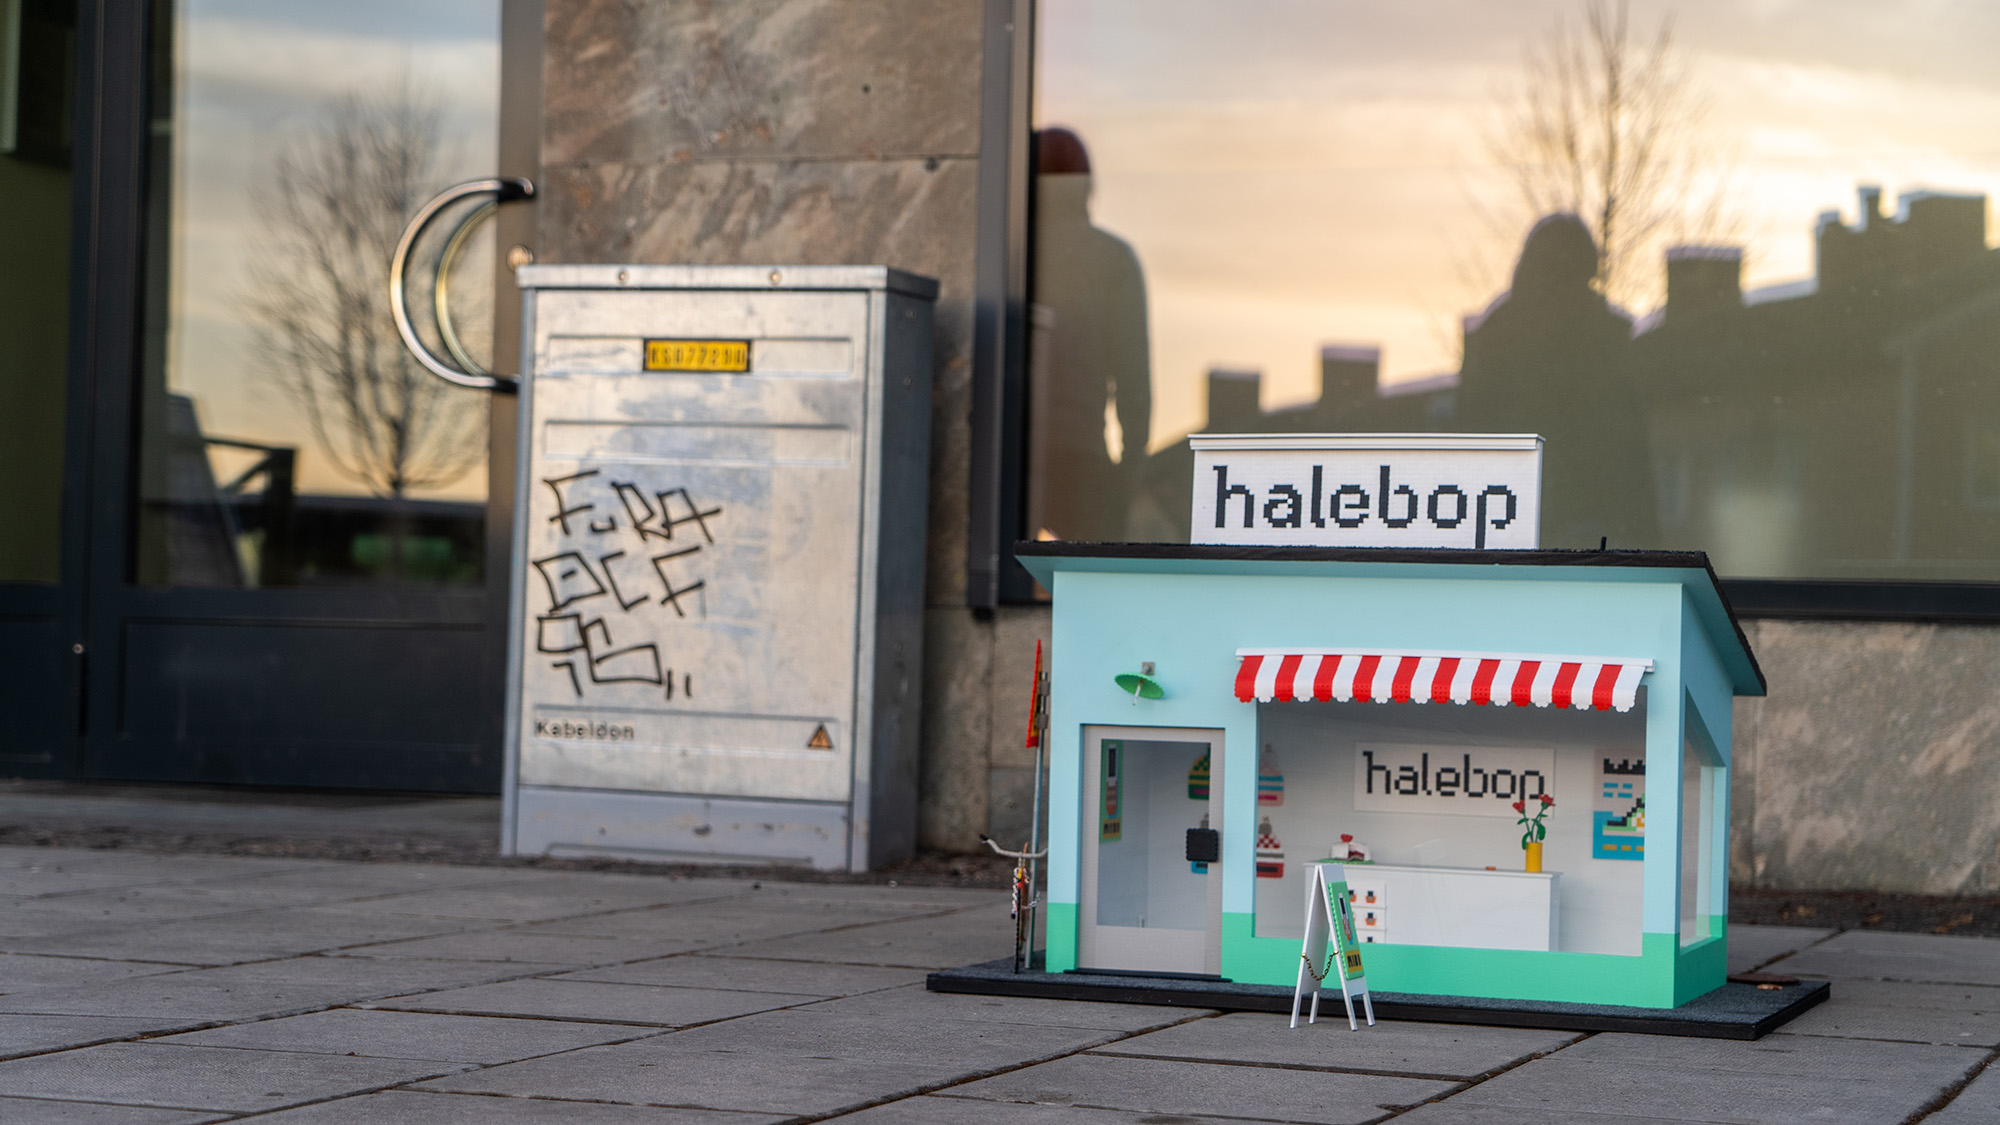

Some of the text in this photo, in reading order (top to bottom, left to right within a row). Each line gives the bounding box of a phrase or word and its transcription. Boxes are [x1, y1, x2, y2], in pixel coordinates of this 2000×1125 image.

[1212, 464, 1518, 550] halebop
[534, 719, 635, 740] Kabeldon
[1362, 750, 1545, 803] halebop
